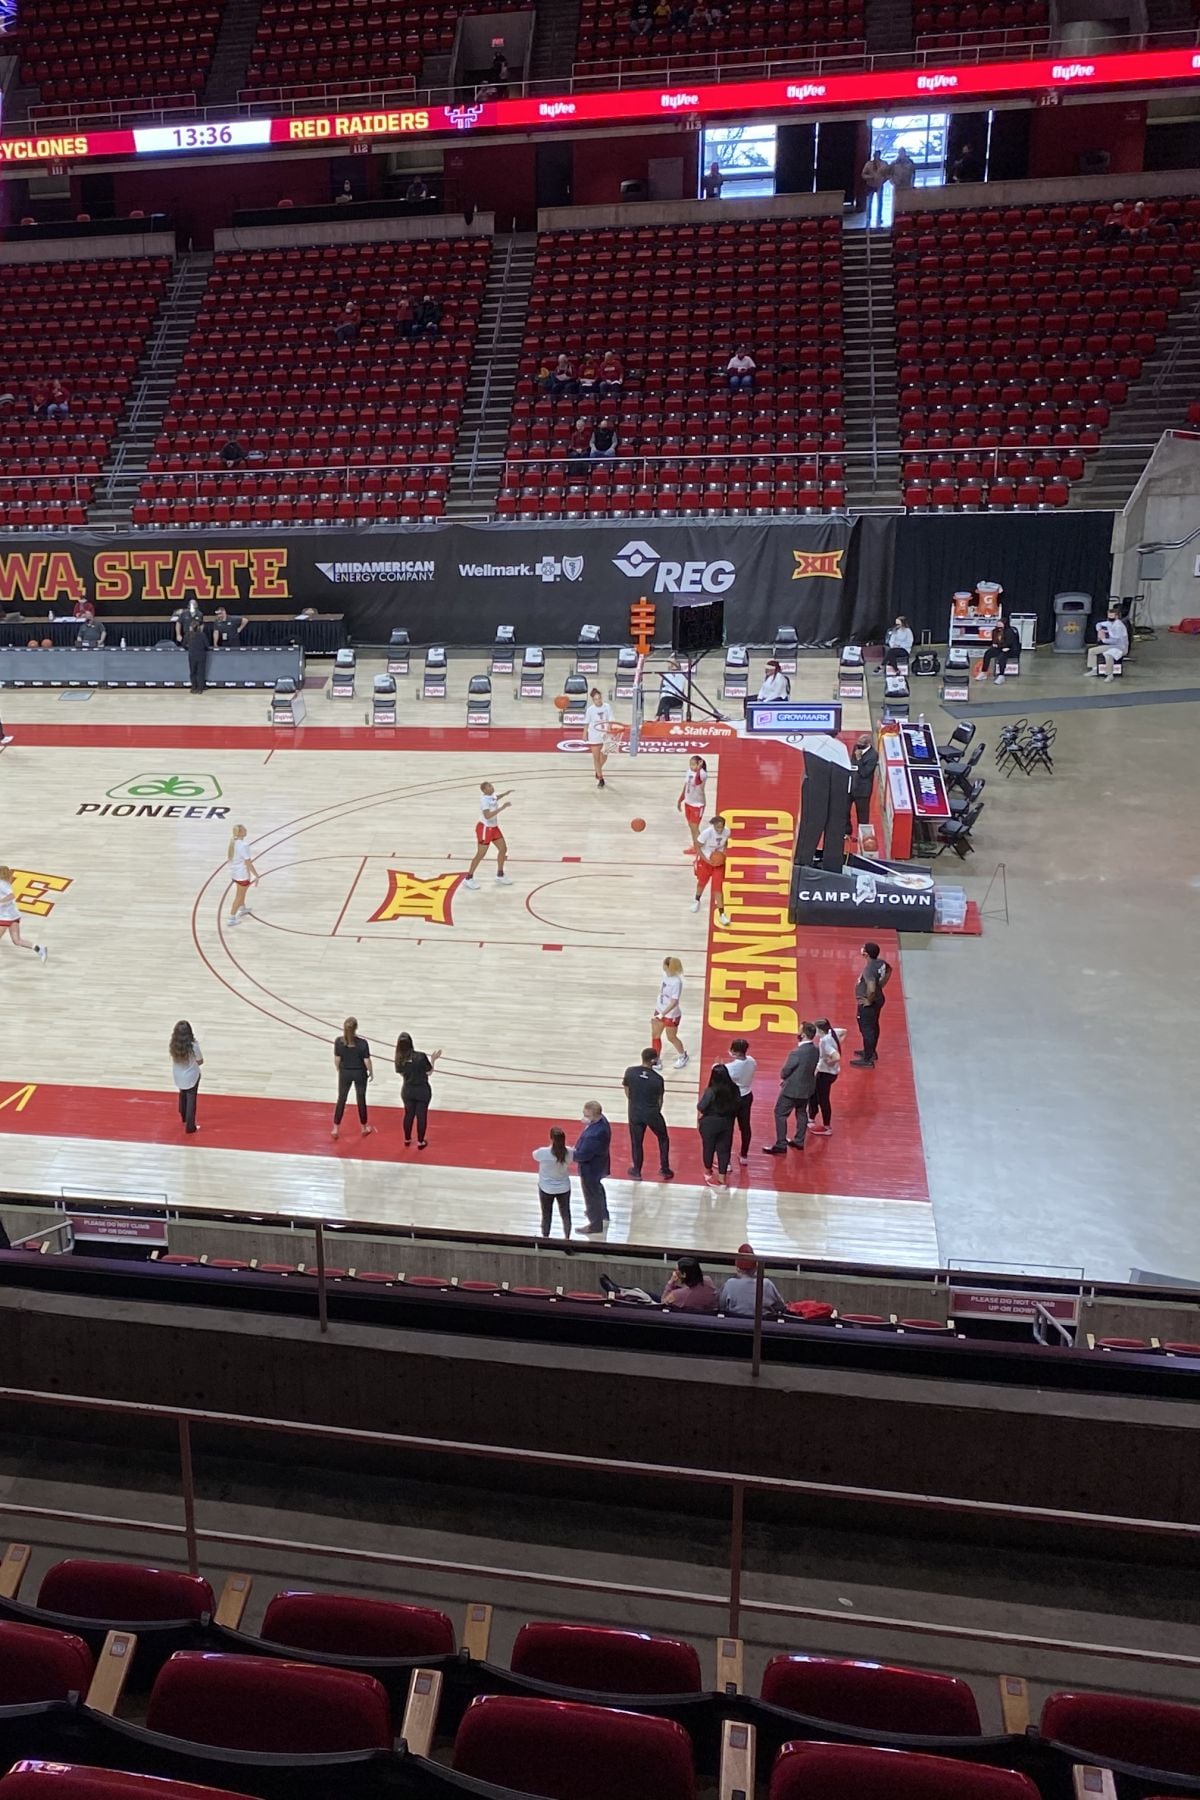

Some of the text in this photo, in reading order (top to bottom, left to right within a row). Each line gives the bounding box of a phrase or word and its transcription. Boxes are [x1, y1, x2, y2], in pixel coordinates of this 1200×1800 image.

[1052, 64, 1095, 80] HyVee
[918, 75, 958, 90] HyVee
[786, 85, 826, 100] HyVee
[661, 94, 699, 108] HyVee
[539, 103, 576, 117] HyVee
[289, 119, 330, 138] RED
[335, 112, 428, 136] RAIDERS
[173, 126, 232, 146] 13:36
[93, 548, 288, 600] STATE
[335, 561, 434, 572] MIDAMERICAN
[335, 572, 376, 582] ENERGY
[654, 560, 736, 593] REG
[76, 803, 230, 820] PIONEER
[708, 809, 798, 1034] CYCLONES
[971, 1296, 998, 1304] PLEASE
